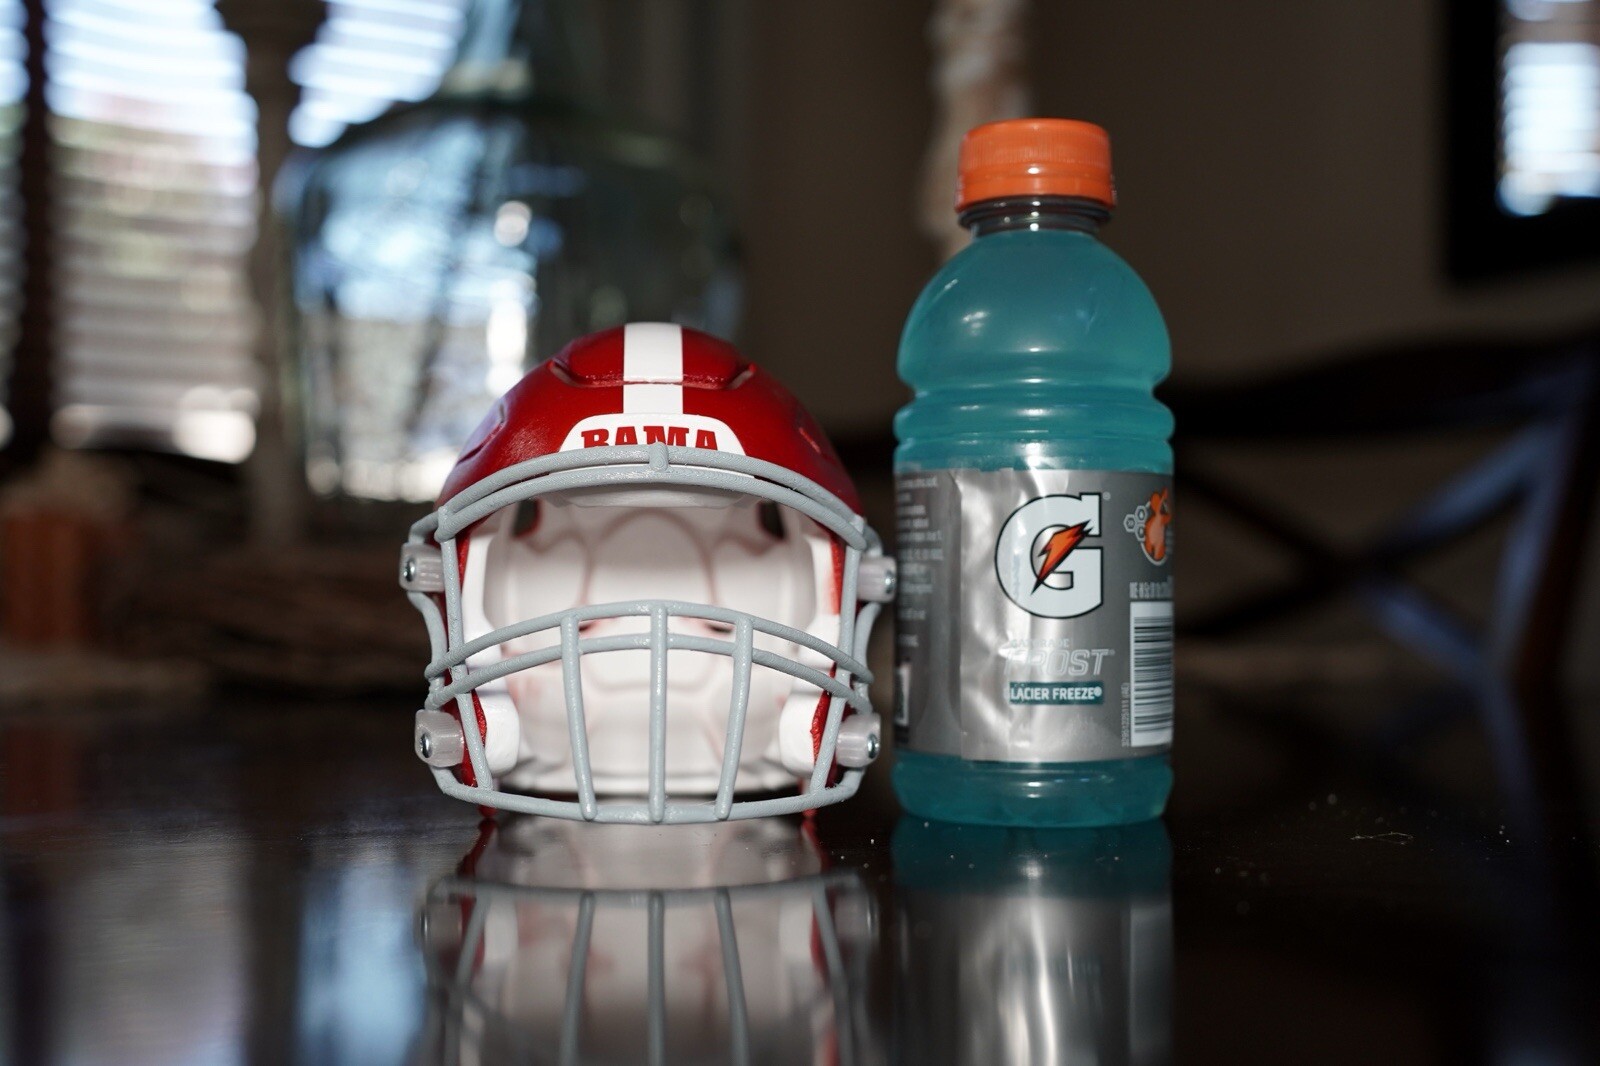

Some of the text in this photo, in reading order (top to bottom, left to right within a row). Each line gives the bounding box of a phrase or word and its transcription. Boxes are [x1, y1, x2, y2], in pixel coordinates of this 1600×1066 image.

[581, 426, 718, 450] BAMA
[995, 492, 1104, 619] G
[1004, 686, 1049, 701] LACIER
